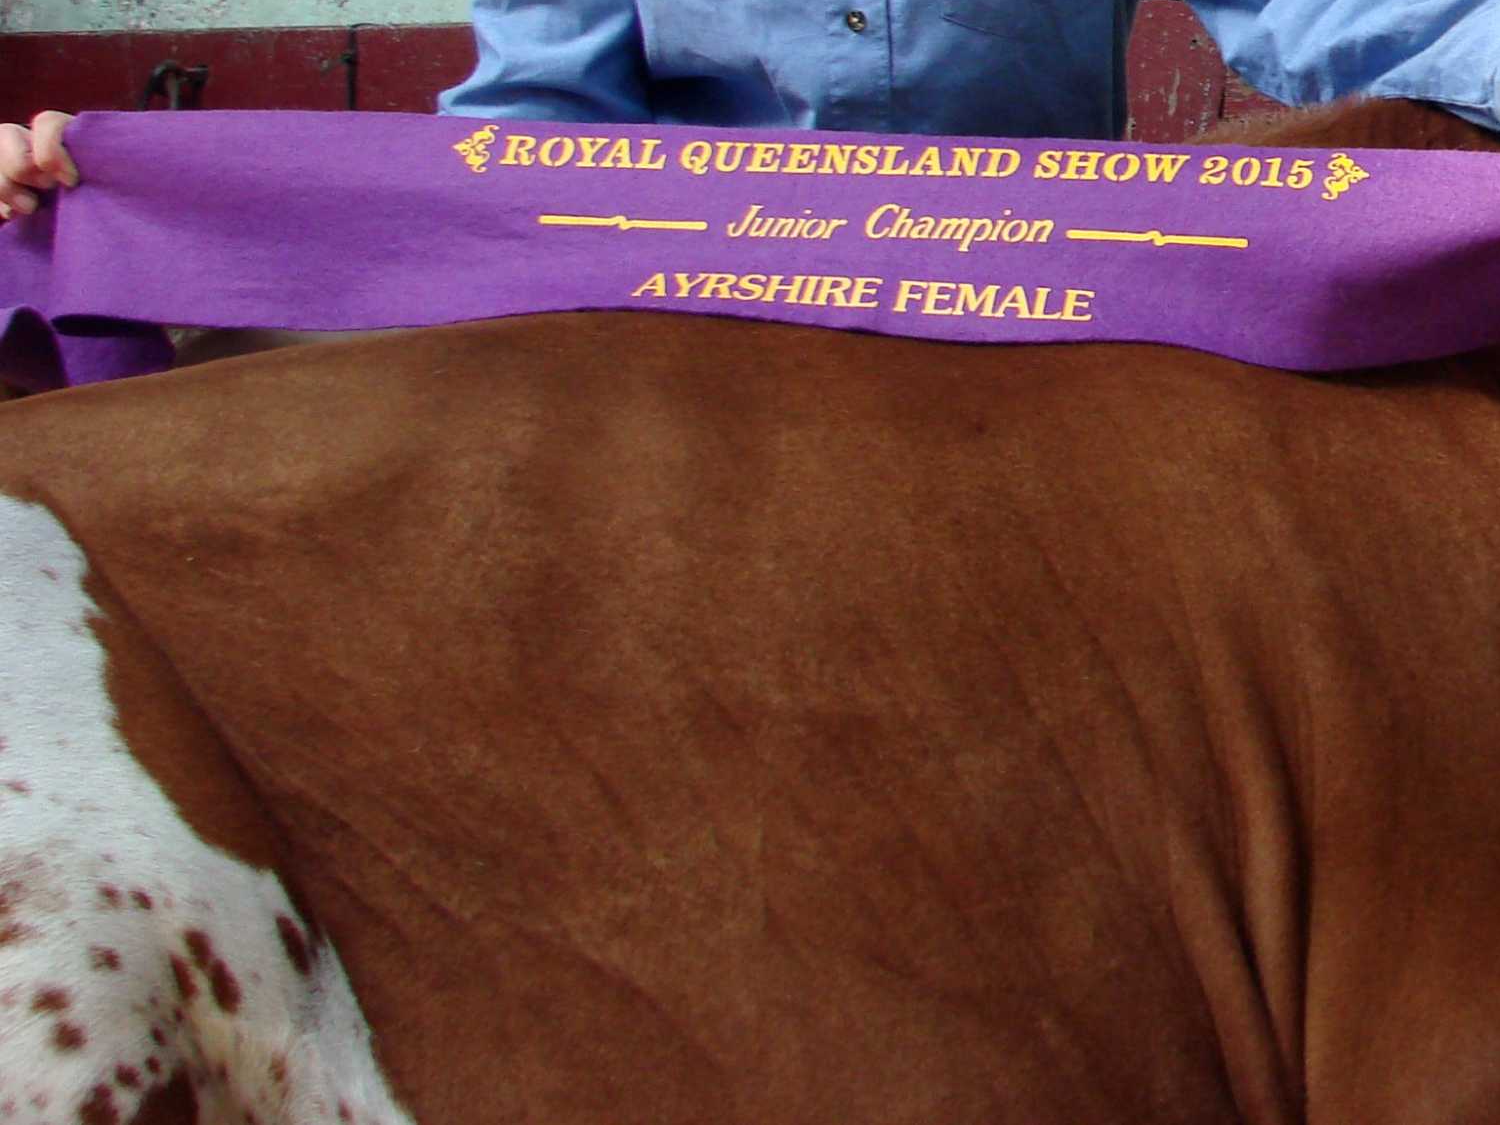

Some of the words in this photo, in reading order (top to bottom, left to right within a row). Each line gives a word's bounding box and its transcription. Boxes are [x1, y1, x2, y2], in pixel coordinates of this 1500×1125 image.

[500, 134, 667, 170] ROYAL
[680, 140, 1020, 179] QUEENSLAND
[1033, 150, 1190, 183] SHOW
[1200, 156, 1314, 189] 2015
[727, 204, 850, 240] Junior
[864, 202, 1055, 252] Champion
[631, 272, 883, 308] AYRSHIRE
[893, 279, 1096, 322] FEMALE
